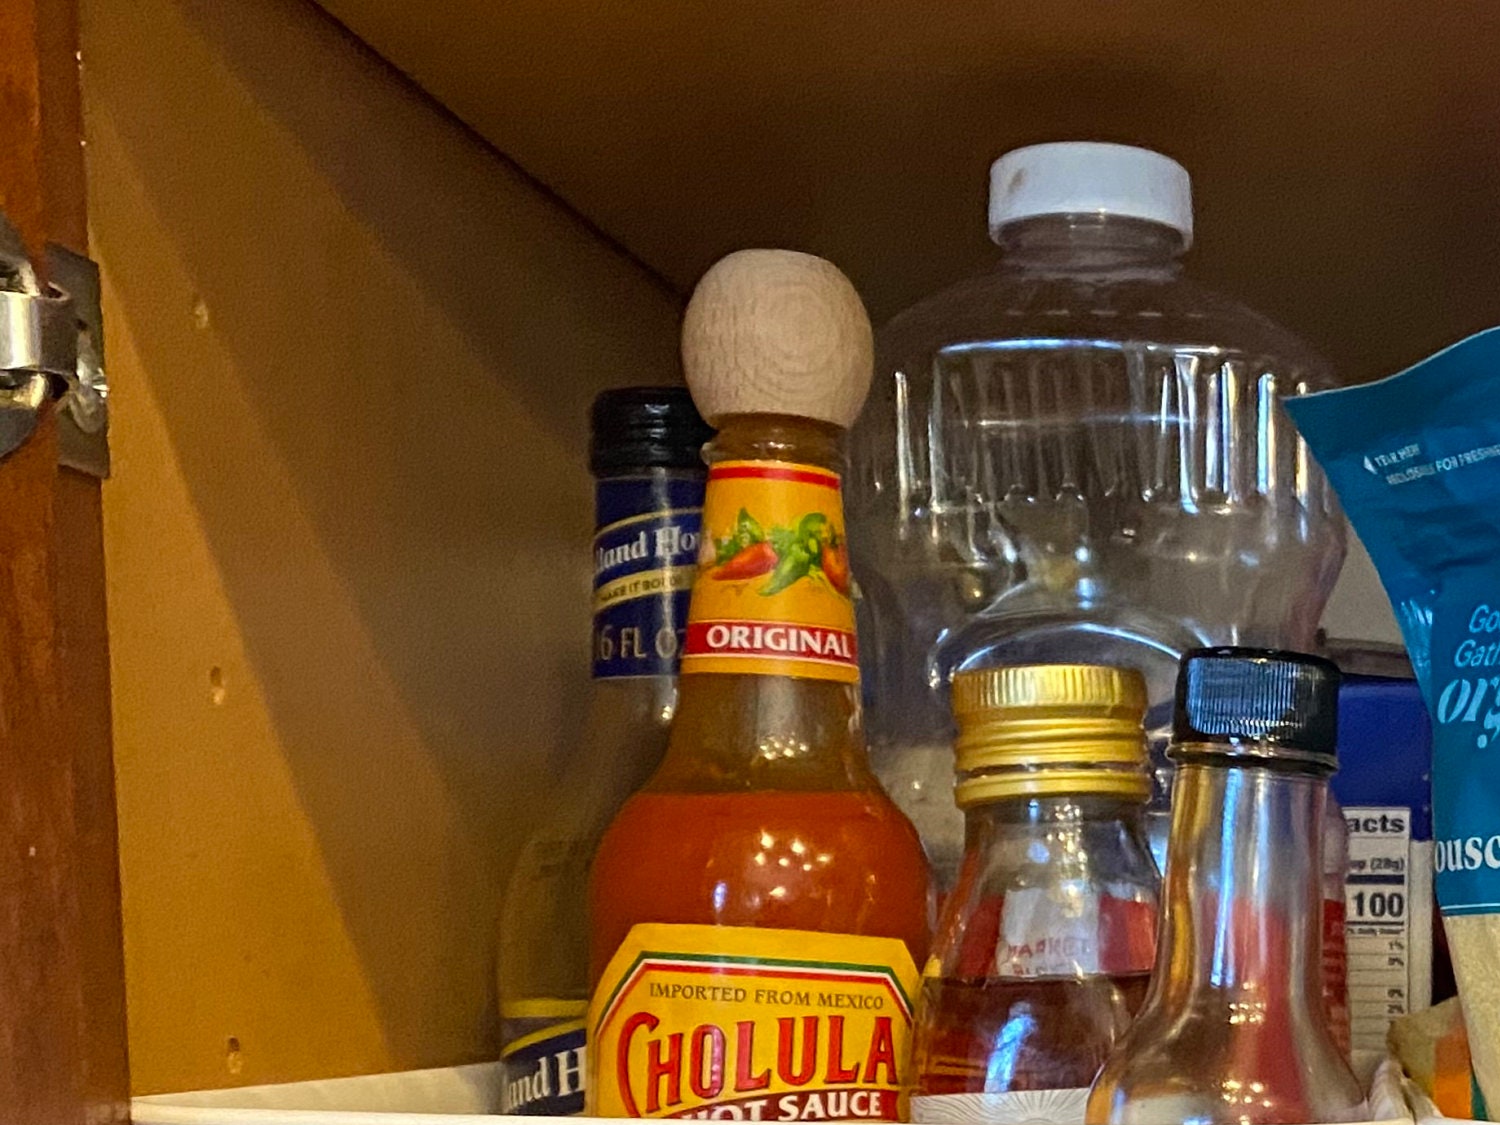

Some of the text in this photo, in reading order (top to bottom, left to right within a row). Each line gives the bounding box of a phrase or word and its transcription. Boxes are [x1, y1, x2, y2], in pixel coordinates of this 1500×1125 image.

[706, 625, 851, 658] ORIGINAL
[1353, 891, 1405, 918] 100
[649, 983, 884, 1010] IMPORTED FROM MEXICO
[616, 1012, 898, 1118] CHOLULA
[777, 1091, 882, 1121] SAUCE
